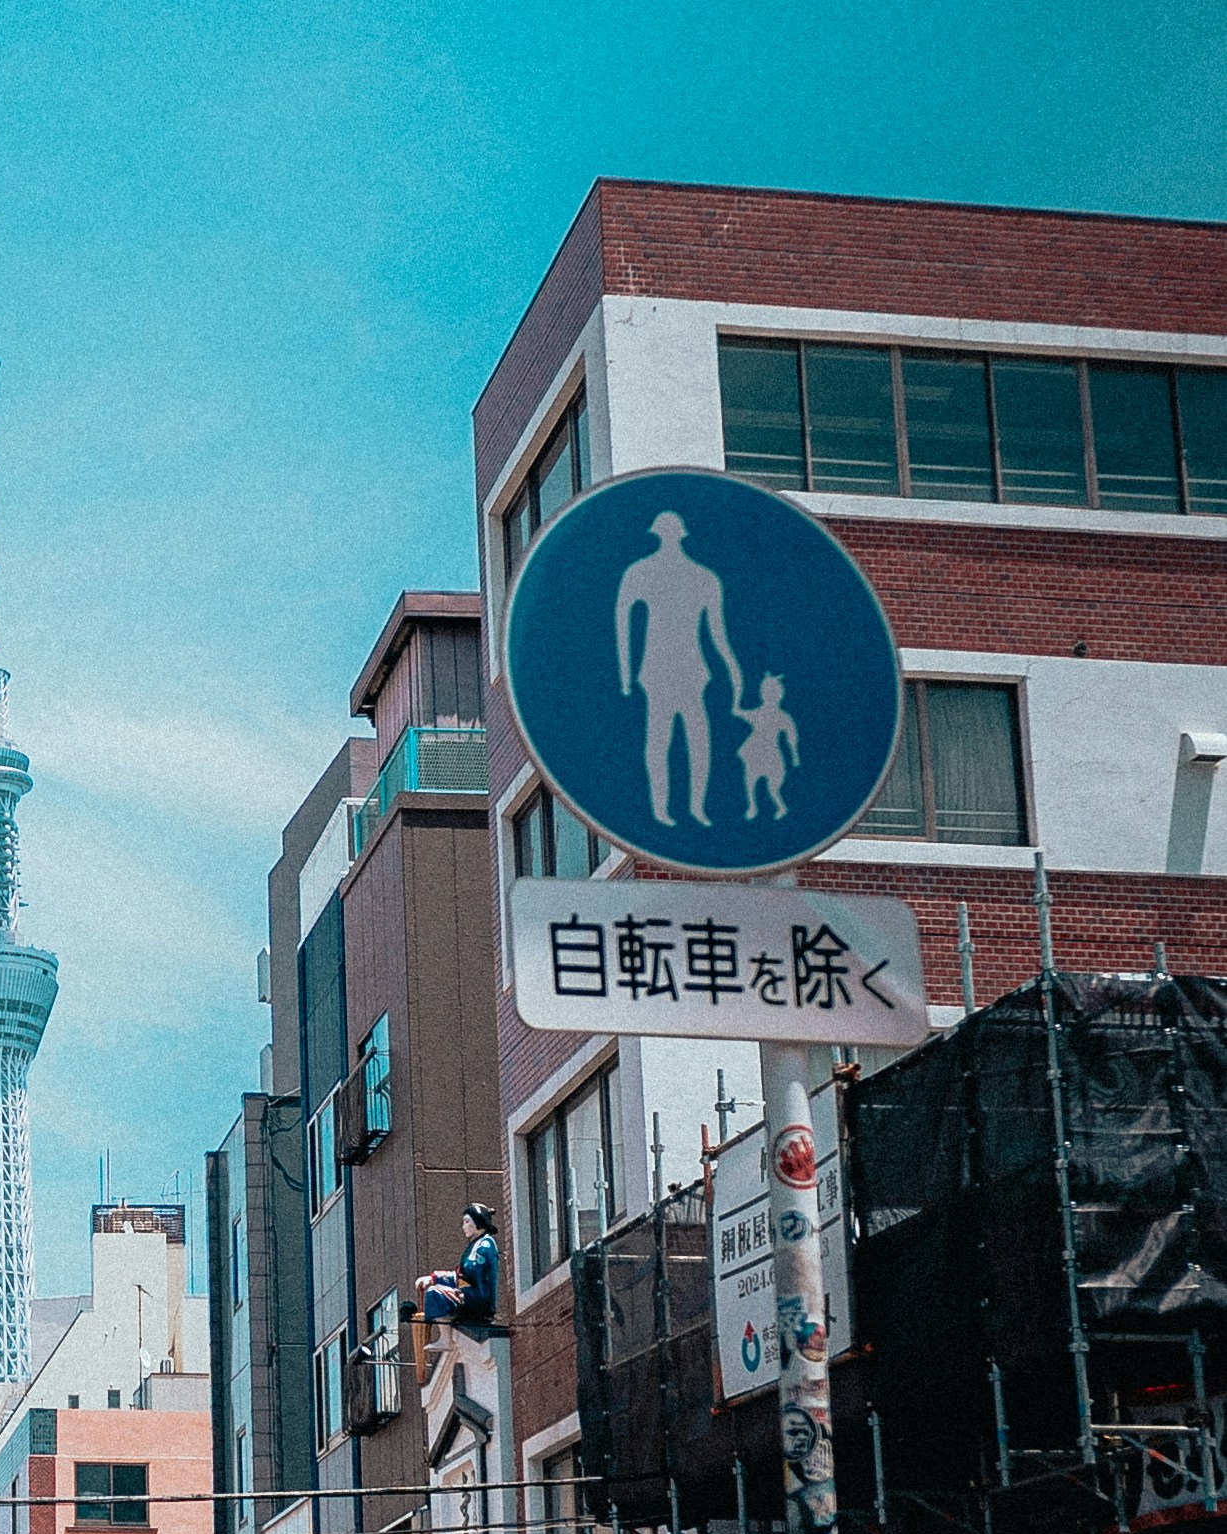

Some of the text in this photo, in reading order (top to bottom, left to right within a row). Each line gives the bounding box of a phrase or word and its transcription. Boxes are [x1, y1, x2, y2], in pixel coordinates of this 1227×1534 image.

[550, 912, 895, 1009] 自転車を除く
